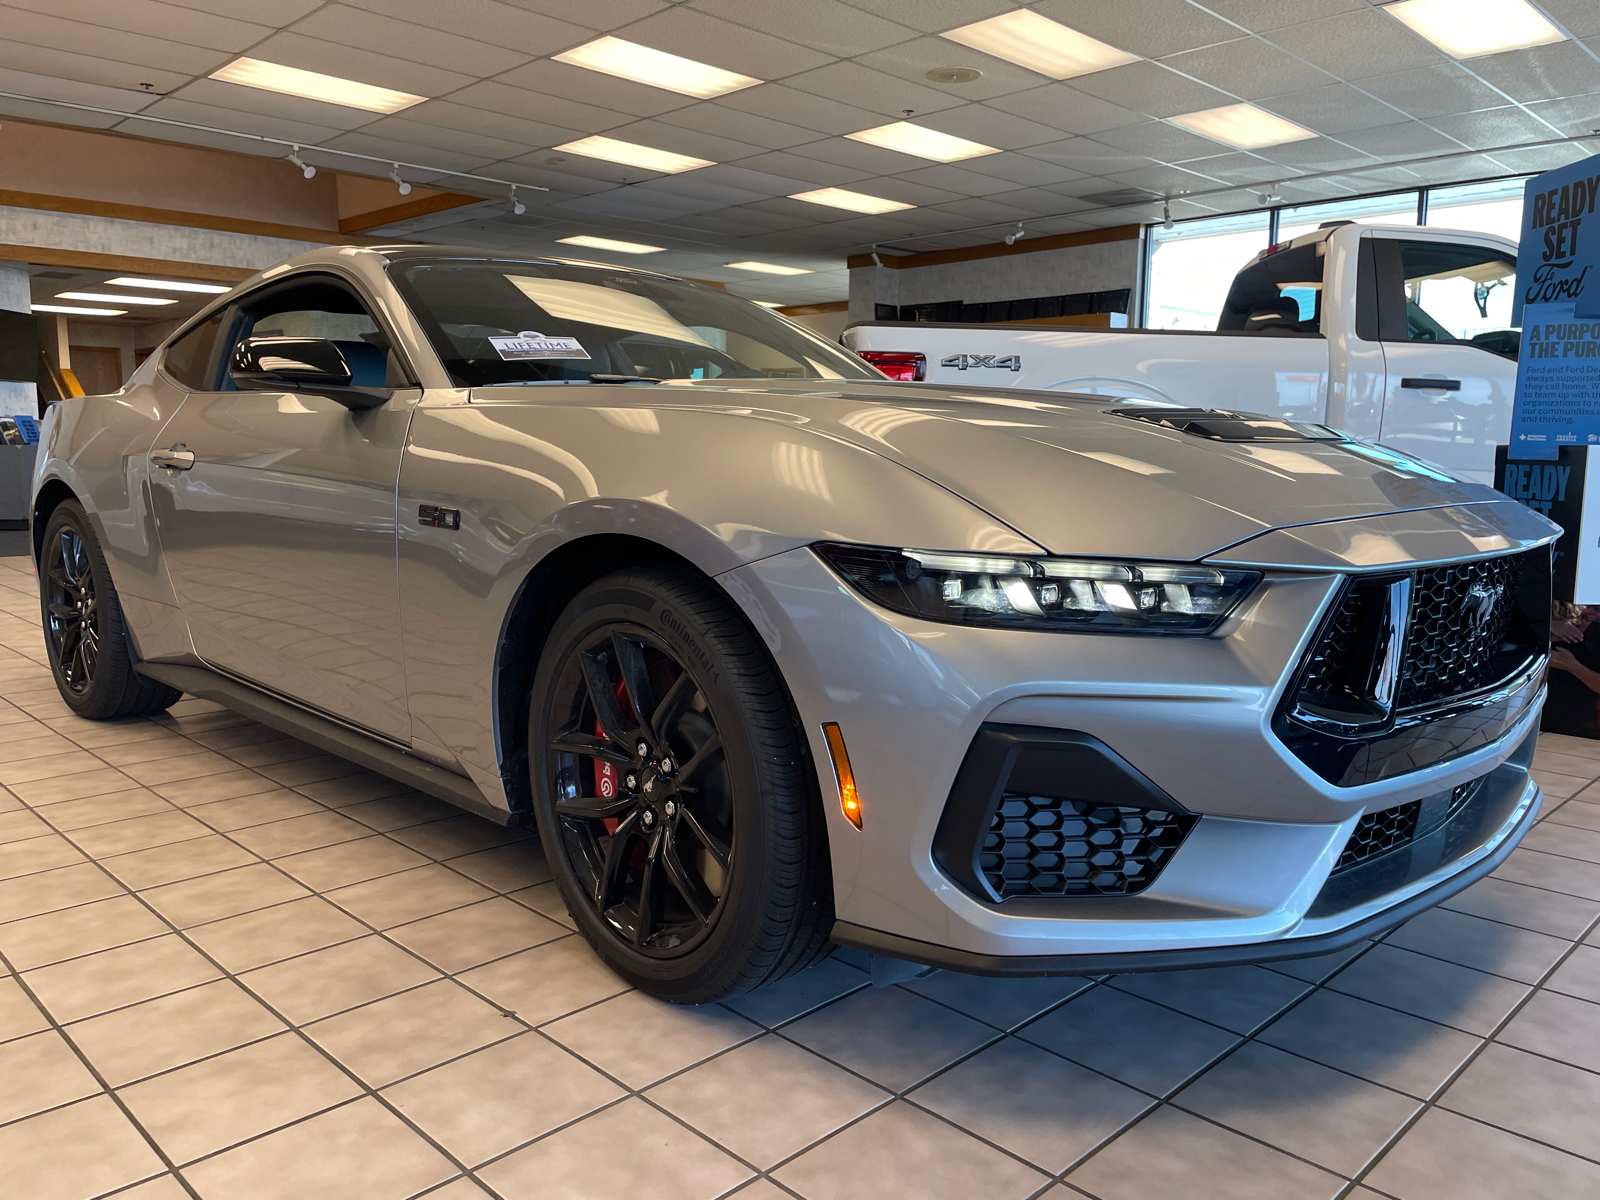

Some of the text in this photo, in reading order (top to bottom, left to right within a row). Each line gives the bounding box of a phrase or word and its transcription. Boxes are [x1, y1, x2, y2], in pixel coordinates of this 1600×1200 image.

[1532, 174, 1600, 230] READY
[1542, 218, 1581, 262] SET
[1525, 260, 1588, 304] Ford
[1529, 323, 1600, 341] A PURPO
[504, 342, 573, 350] LIFETIME
[1529, 341, 1600, 358] THE PUR
[1527, 366, 1545, 374] Ford
[1547, 366, 1563, 374] and
[1566, 366, 1585, 374] Ford
[1526, 374, 1600, 383] always supported
[1525, 383, 1543, 391] they
[1545, 382, 1560, 390] call
[1558, 393, 1569, 401] up
[1571, 391, 1590, 399] with
[1523, 400, 1581, 408] organizations
[1538, 407, 1595, 416] communities
[1504, 464, 1571, 501] READY
[660, 609, 715, 674] Continental
